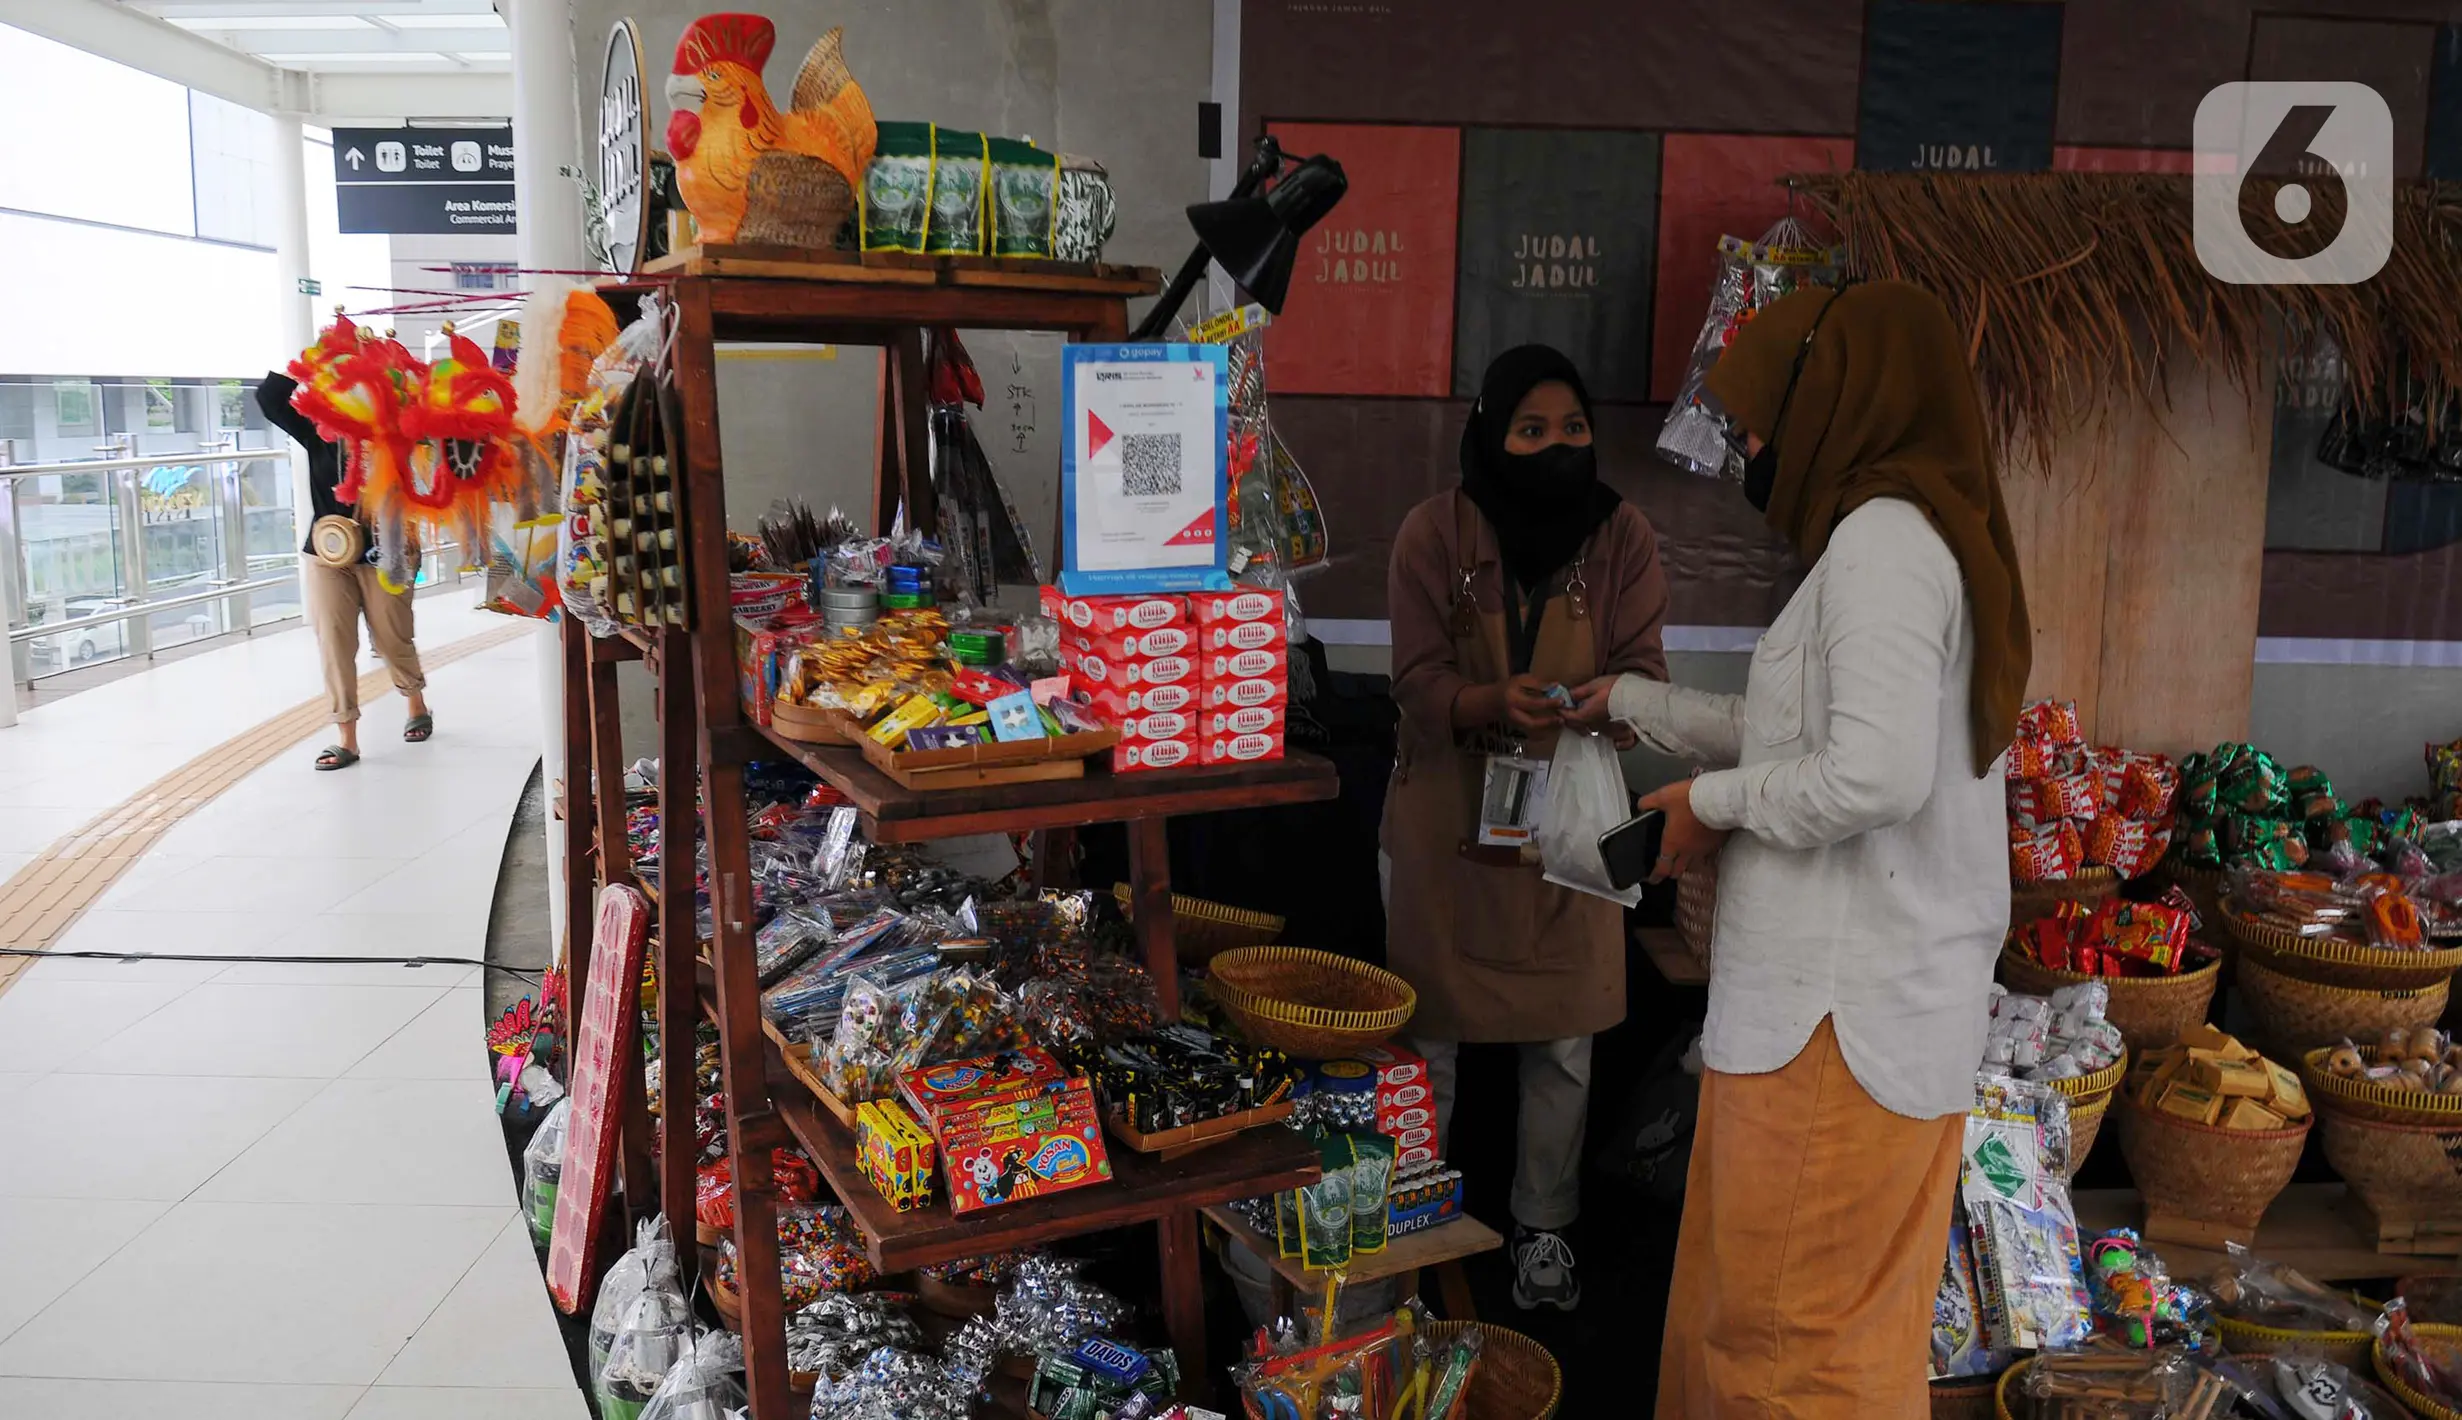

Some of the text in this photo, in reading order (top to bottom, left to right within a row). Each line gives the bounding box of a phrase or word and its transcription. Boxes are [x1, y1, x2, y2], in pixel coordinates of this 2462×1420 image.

[412, 144, 445, 157] Toilet
[1911, 143, 1998, 171] JUDAL
[413, 158, 441, 170] Toilet
[445, 200, 471, 212] Area
[450, 213, 504, 225] Commercial
[1316, 229, 1404, 254] JUDAL
[1514, 234, 1601, 260] JUDAL
[1315, 258, 1404, 283] JADUL
[1512, 263, 1600, 288] JADUL
[1228, 321, 1240, 334] AA
[1139, 603, 1168, 617] Milk
[1236, 597, 1264, 610] Milk
[1239, 626, 1266, 638] Milk
[1149, 632, 1178, 646] Milk
[1152, 659, 1181, 674] Milk
[1239, 654, 1267, 666] Milk
[1152, 688, 1180, 701] Milk
[1237, 683, 1266, 696] Milk
[1148, 716, 1177, 729] Milk
[1237, 711, 1265, 724] Milk
[1151, 743, 1180, 757] Milk
[1237, 737, 1264, 750] Milk
[1392, 1066, 1413, 1078] Milk
[944, 1068, 979, 1090] YOSAN
[1400, 1088, 1420, 1100] Milk
[1403, 1110, 1423, 1122] Milk
[1405, 1129, 1426, 1141] Milk
[1036, 1139, 1072, 1172] YOSAN
[1405, 1150, 1426, 1162] Milk
[1388, 1214, 1431, 1237] DUPLEX
[1085, 1341, 1134, 1371] DAVOS
